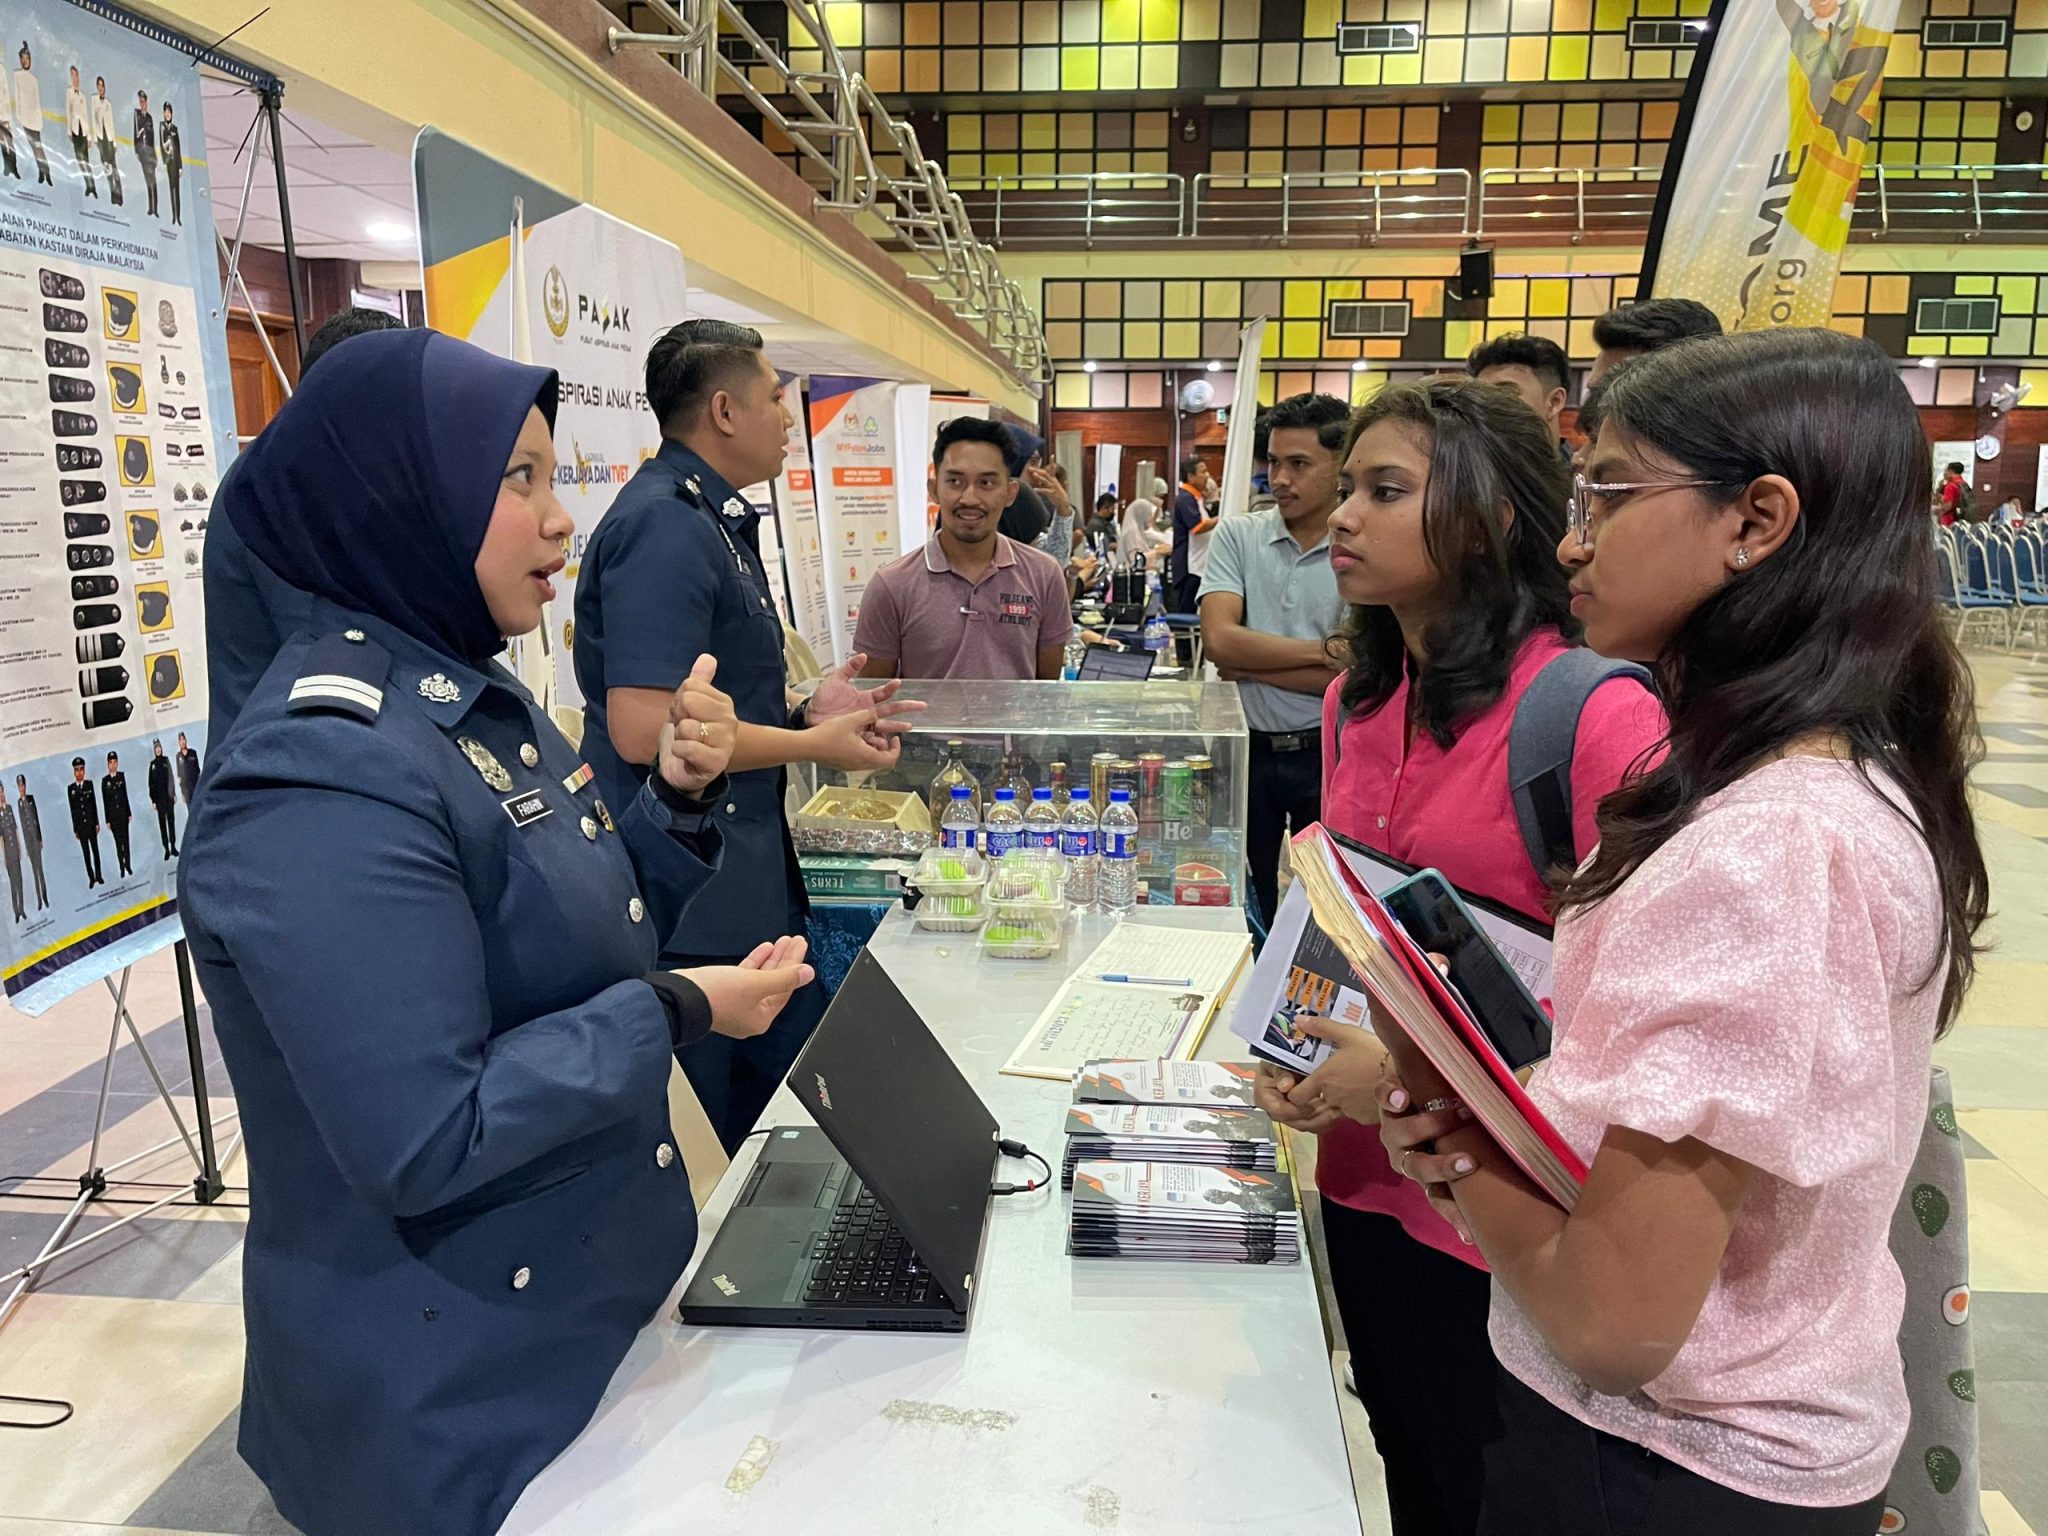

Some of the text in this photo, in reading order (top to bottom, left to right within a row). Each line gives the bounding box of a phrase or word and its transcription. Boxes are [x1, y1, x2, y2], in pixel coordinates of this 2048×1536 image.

[0, 212, 25, 228] AIAN
[27, 218, 67, 239] PANGKAT
[69, 230, 100, 245] DALAM
[101, 238, 159, 260] PERKHIDMATAN
[38, 238, 73, 255] KASTAM
[75, 248, 105, 263] DIRAJA
[107, 255, 145, 272] MALAYSIA
[1770, 259, 1807, 323] org
[558, 381, 603, 407] SPIRASI
[606, 388, 632, 410] ANAK
[557, 464, 629, 485] KERJAYA DAN TVET
[811, 877, 845, 889] TEXAS
[1137, 1179, 1150, 1203] KERJAYA
